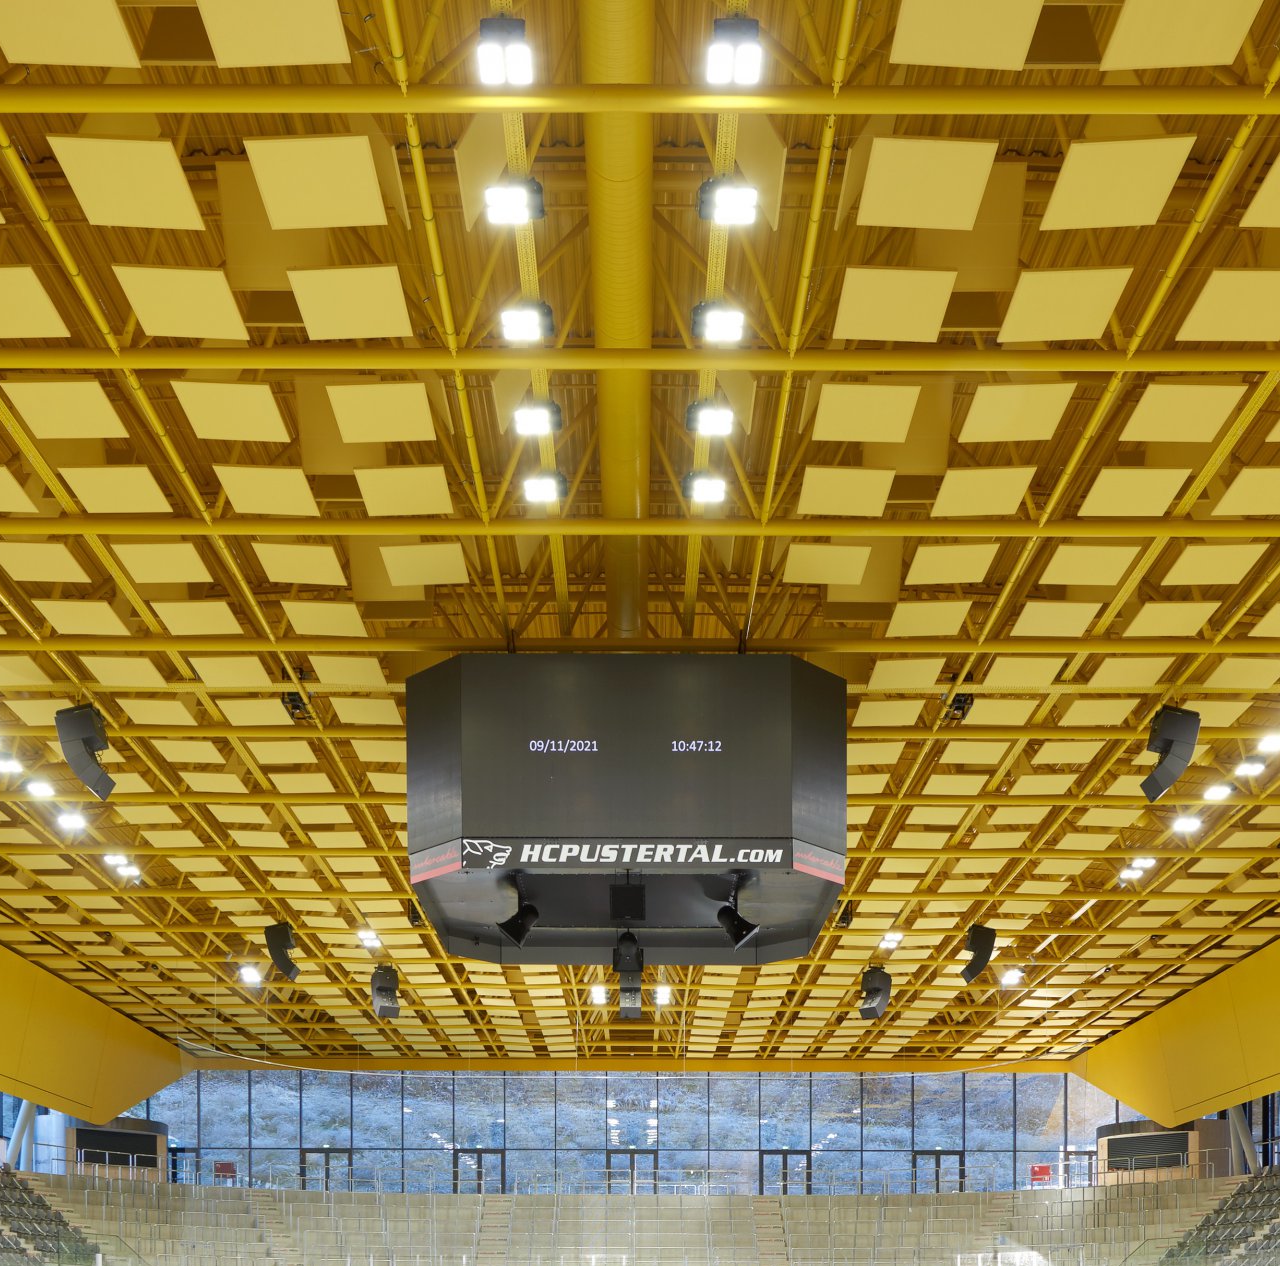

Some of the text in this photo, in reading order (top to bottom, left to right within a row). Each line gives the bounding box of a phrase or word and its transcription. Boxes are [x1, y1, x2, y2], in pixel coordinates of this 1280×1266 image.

[529, 739, 598, 753] 09/11/2021
[671, 740, 721, 753] 10:47:12
[520, 843, 783, 864] HCPUSTERTAL.COM
